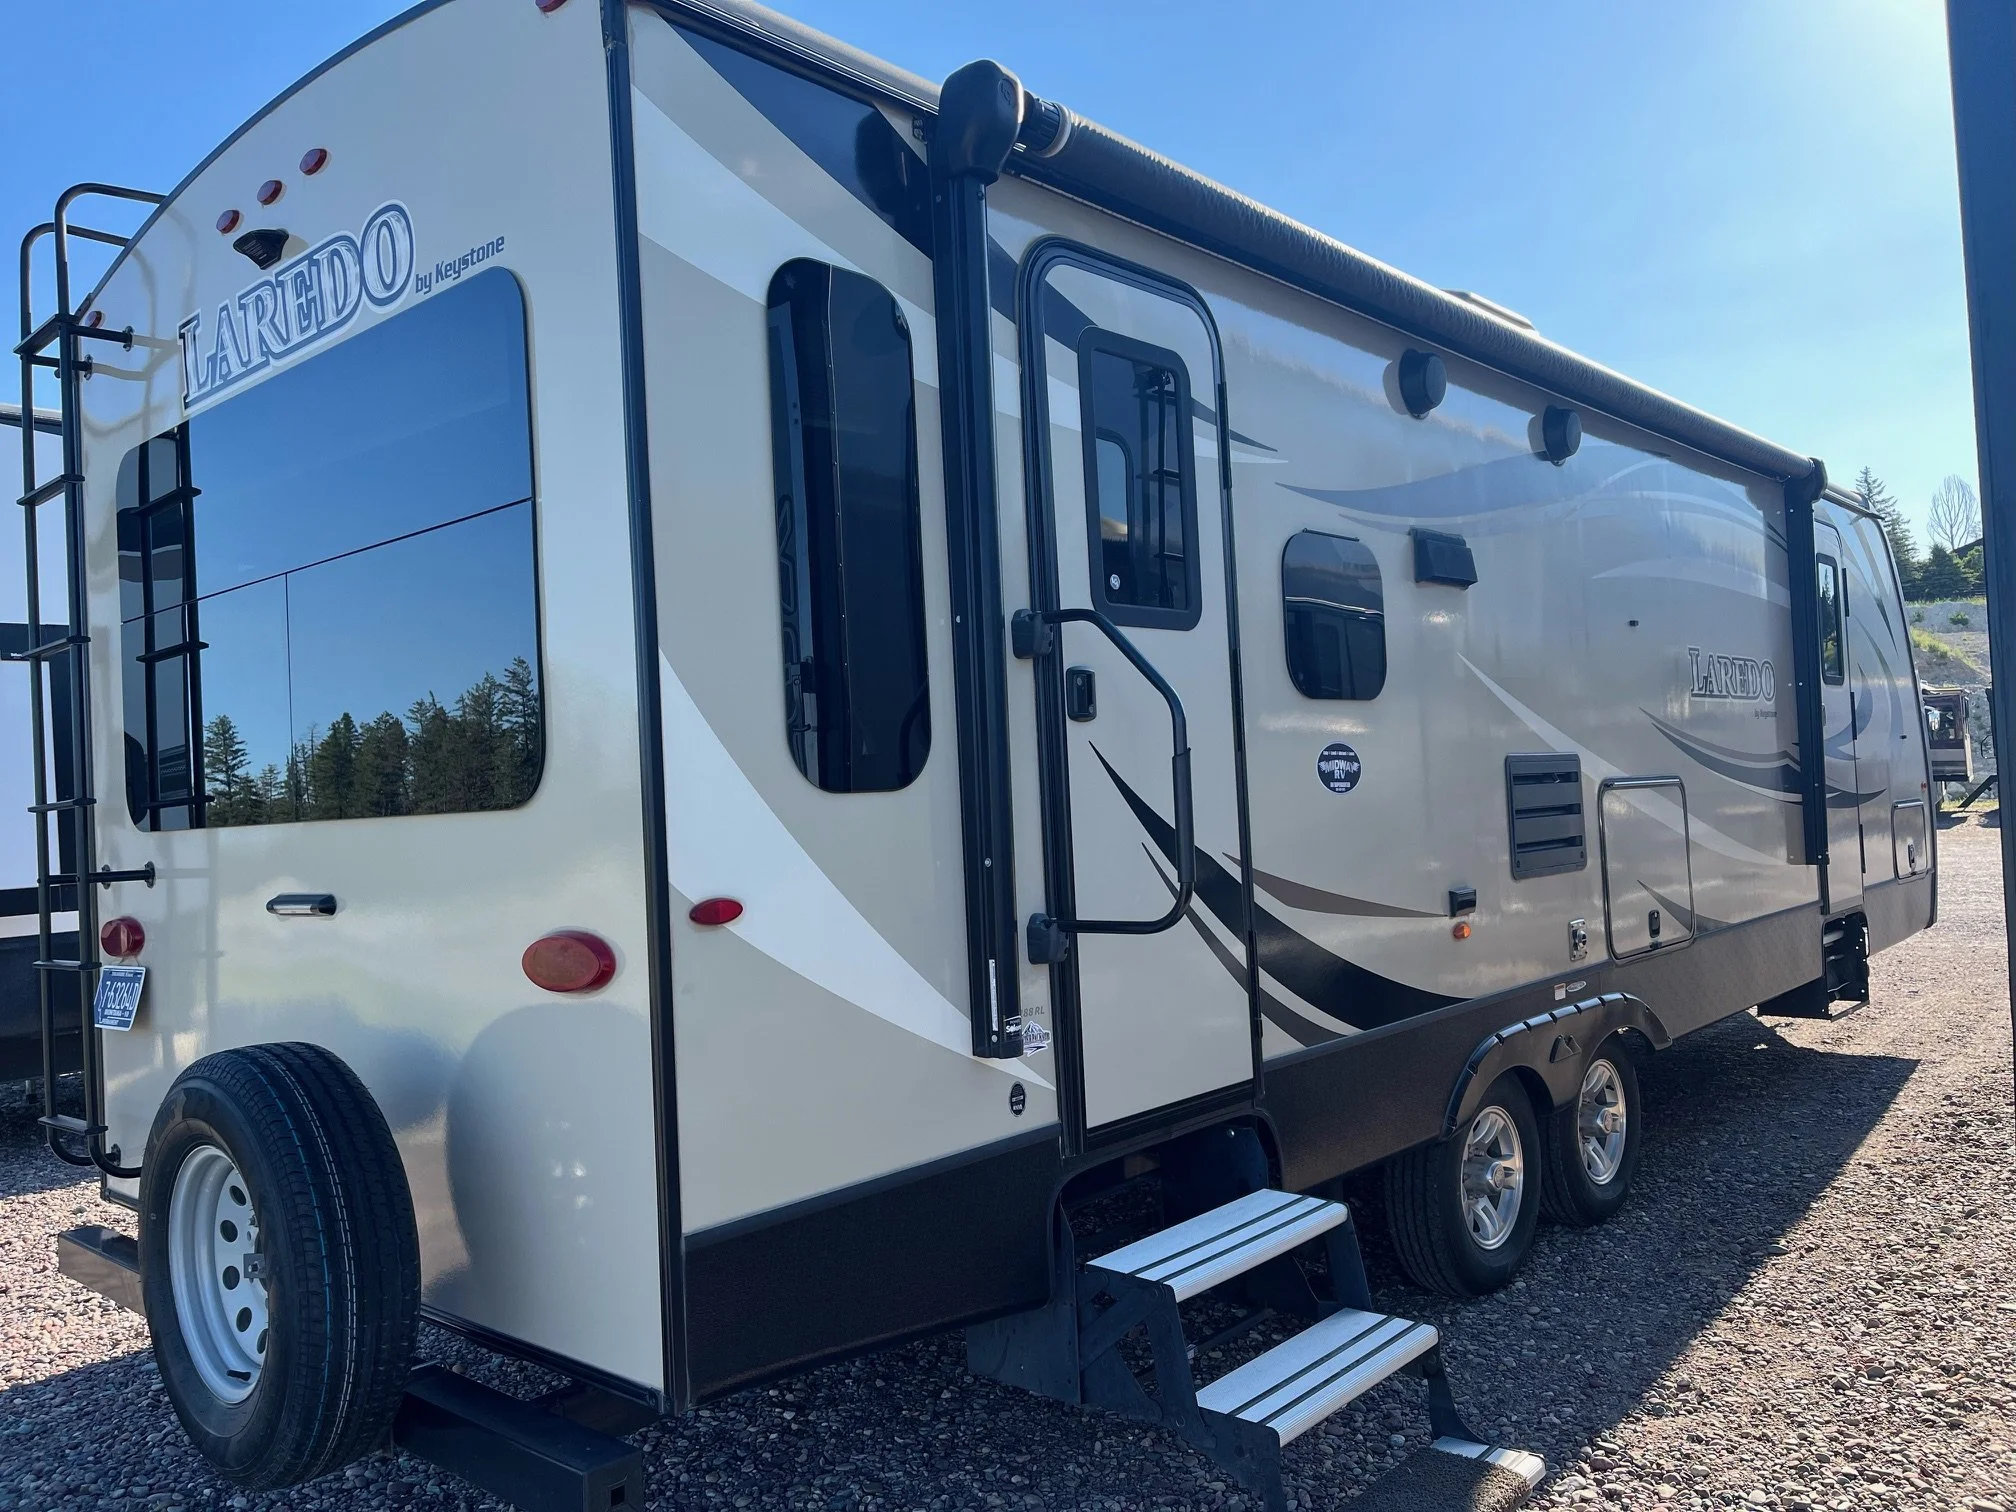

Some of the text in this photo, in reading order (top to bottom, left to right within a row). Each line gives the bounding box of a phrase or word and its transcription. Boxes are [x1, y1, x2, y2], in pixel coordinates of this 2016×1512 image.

[178, 201, 414, 413] LAREDO
[415, 271, 432, 294] by
[434, 235, 506, 283] Keystone
[1688, 646, 1776, 702] LAREDO
[1324, 760, 1355, 773] MIDWAY
[1334, 769, 1346, 779] RV
[1021, 1005, 1045, 1017] 88 RL
